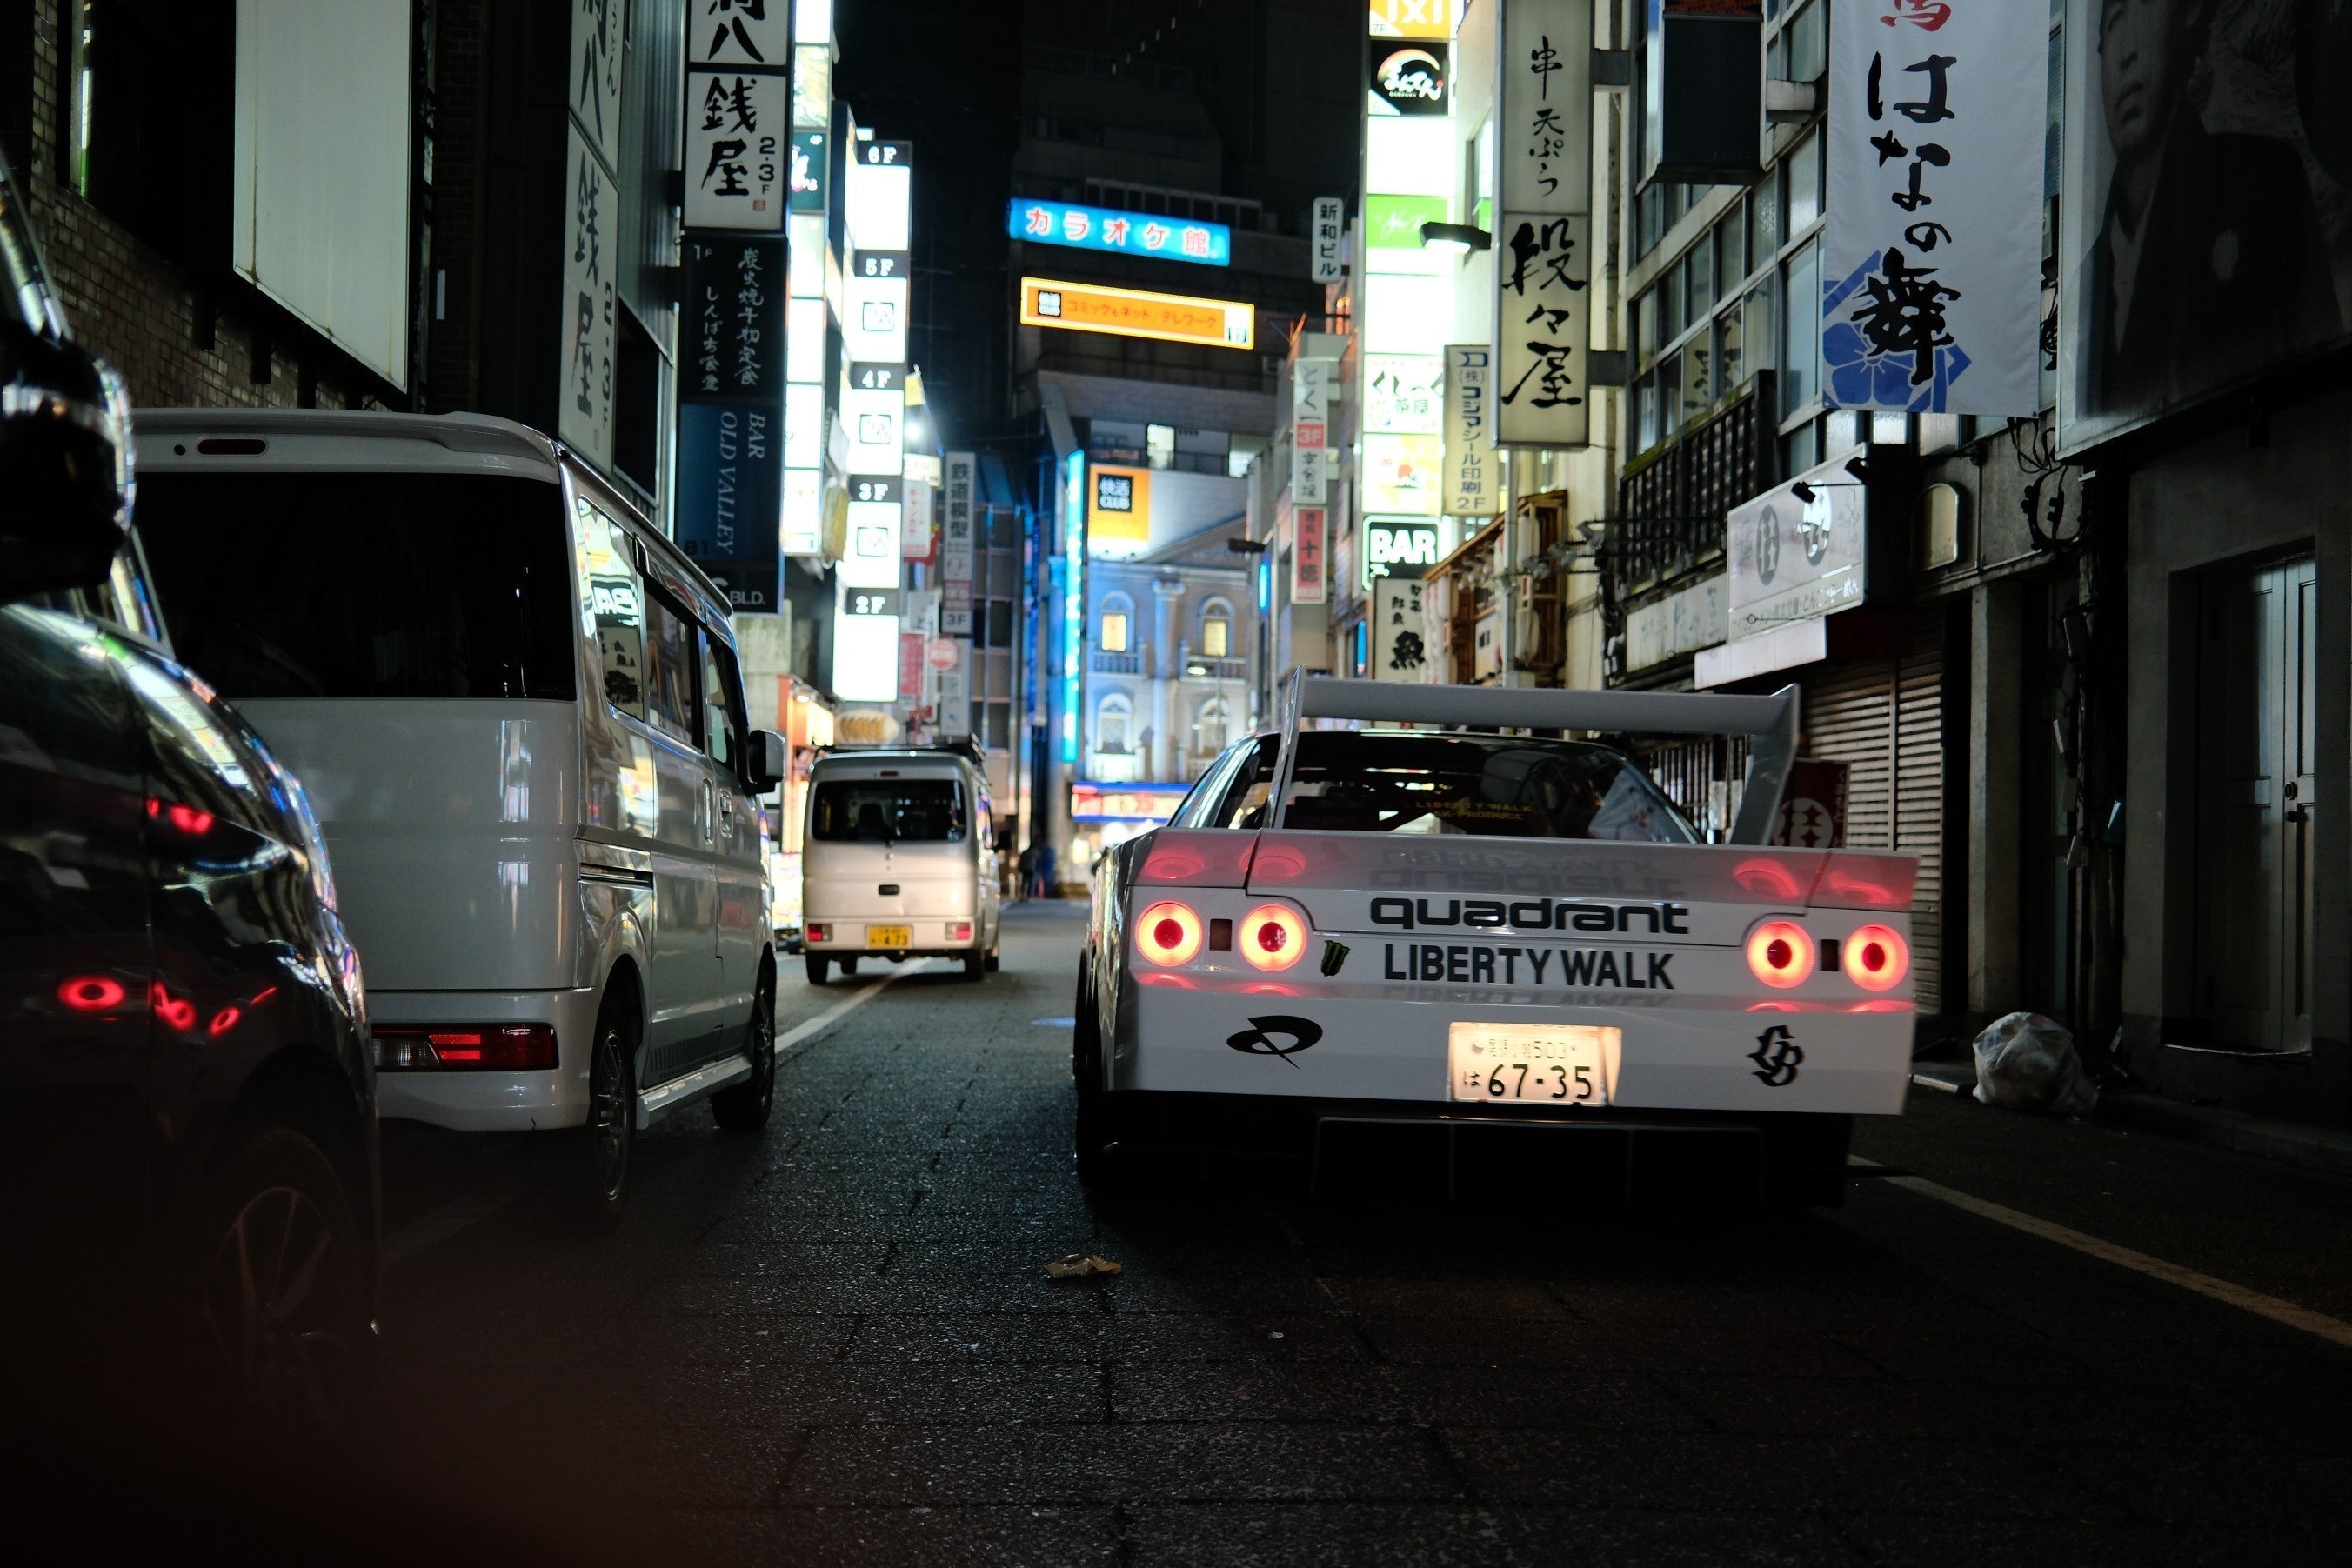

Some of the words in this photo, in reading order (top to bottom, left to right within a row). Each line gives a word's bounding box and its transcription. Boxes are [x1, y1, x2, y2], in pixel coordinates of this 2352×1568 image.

[868, 146, 897, 164] 6F
[1026, 208, 1209, 257] カラオケ館
[1850, 50, 1961, 386] はなの舞
[1319, 204, 1337, 277] 新和ビル
[865, 257, 894, 277] 5F
[862, 370, 892, 389] 4F
[719, 411, 738, 461] OLD
[747, 412, 766, 460] BAR
[859, 482, 889, 501] 3F
[1457, 497, 1486, 510] 2F
[716, 467, 737, 555] VALLEY
[1370, 529, 1436, 564] BAR
[729, 591, 766, 606] BLD.
[855, 595, 885, 614] 2F
[946, 613, 967, 626] 3F
[1371, 897, 1690, 935] quadrant
[1384, 944, 1554, 987] LIBERTY
[1563, 950, 1675, 990] WALK
